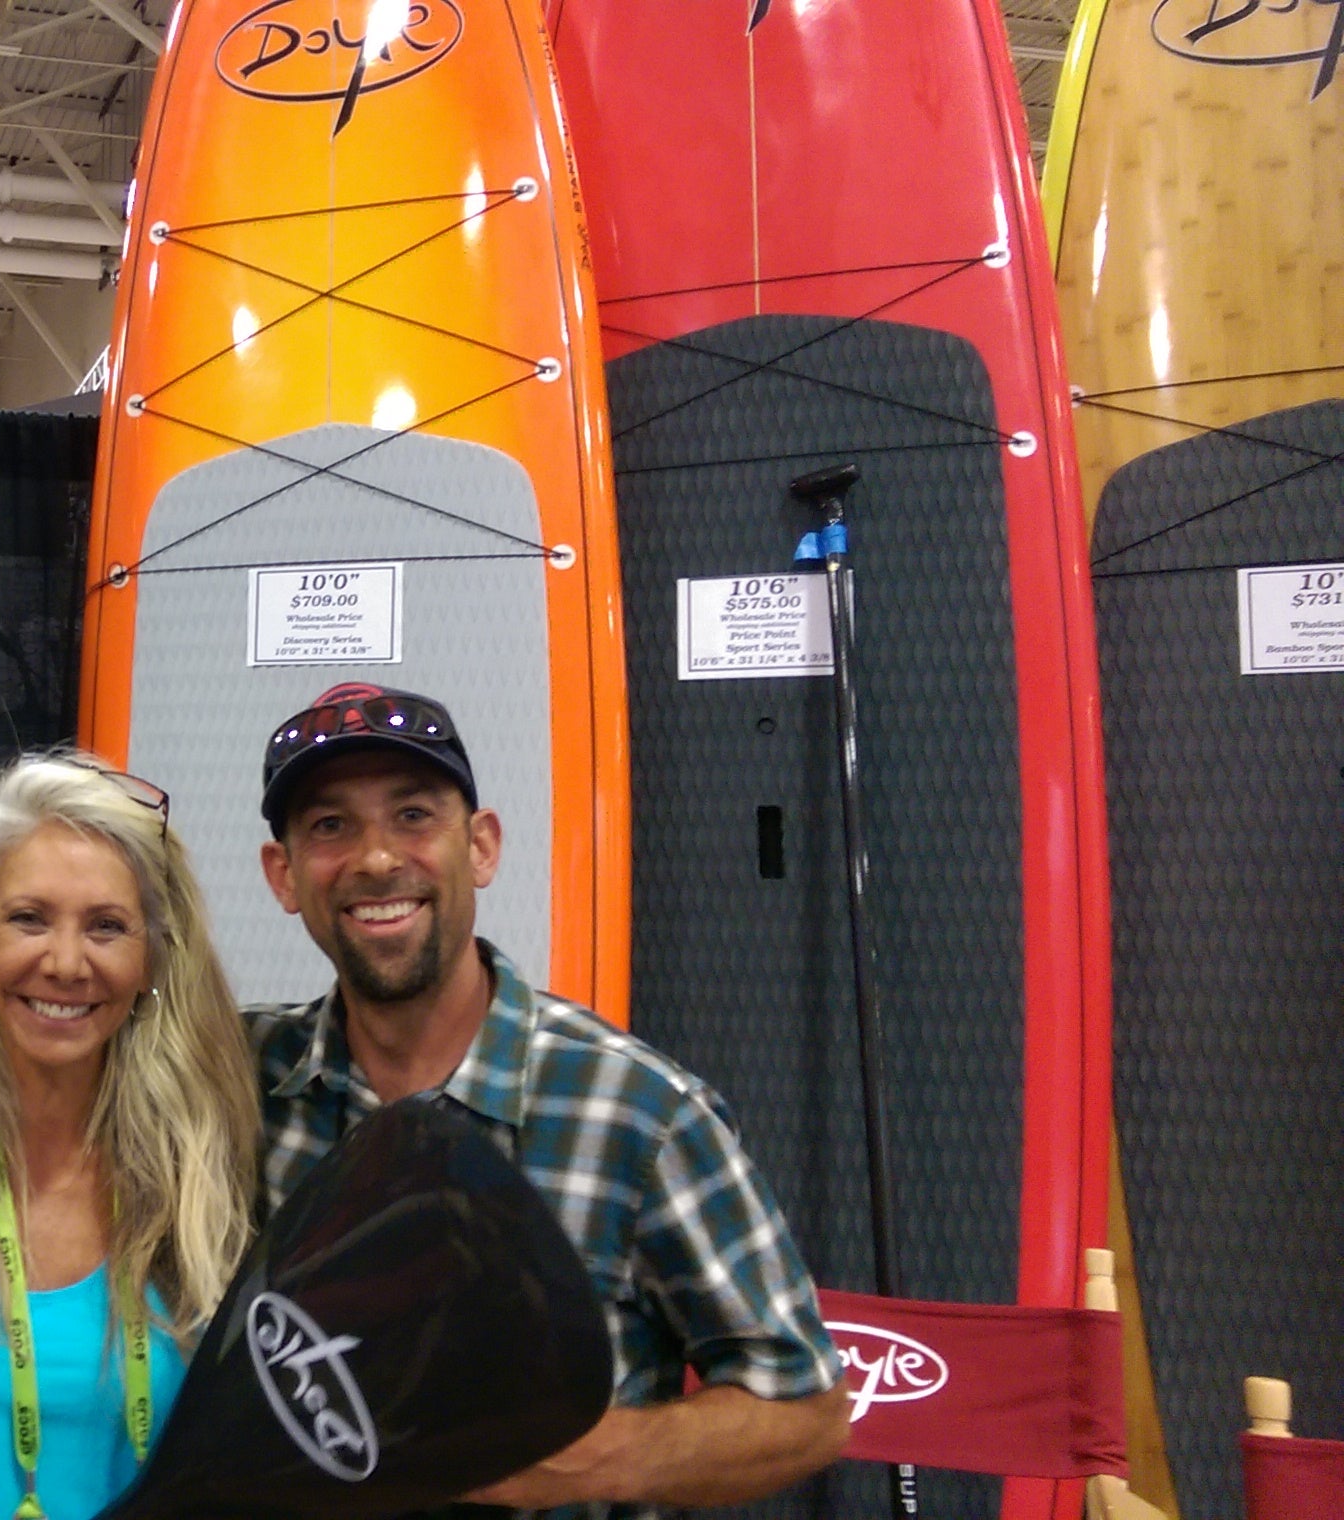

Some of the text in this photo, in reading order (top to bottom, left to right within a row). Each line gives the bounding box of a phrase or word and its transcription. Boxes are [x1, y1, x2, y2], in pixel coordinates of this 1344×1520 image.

[240, 5, 445, 141] Doye
[1300, 572, 1344, 590] 10'
[290, 594, 358, 608] $709.00
[725, 596, 801, 612] $575.00
[1291, 592, 1342, 608] $731
[286, 613, 363, 623] Wholesale Price
[720, 612, 806, 622] Wholesale Price
[1290, 621, 1344, 629] Wholesa
[283, 635, 362, 646] Discovery Series
[730, 630, 797, 641] Price Point
[726, 642, 801, 655] Sport Series
[1265, 644, 1344, 653] Bamboo Spor
[738, 655, 753, 664] 31
[798, 654, 806, 662] 4
[1329, 654, 1344, 663] 31
[10, 1318, 25, 1370] crocs
[134, 1320, 146, 1361] rocs
[837, 1344, 934, 1423] oyle
[17, 1405, 29, 1455] crocs
